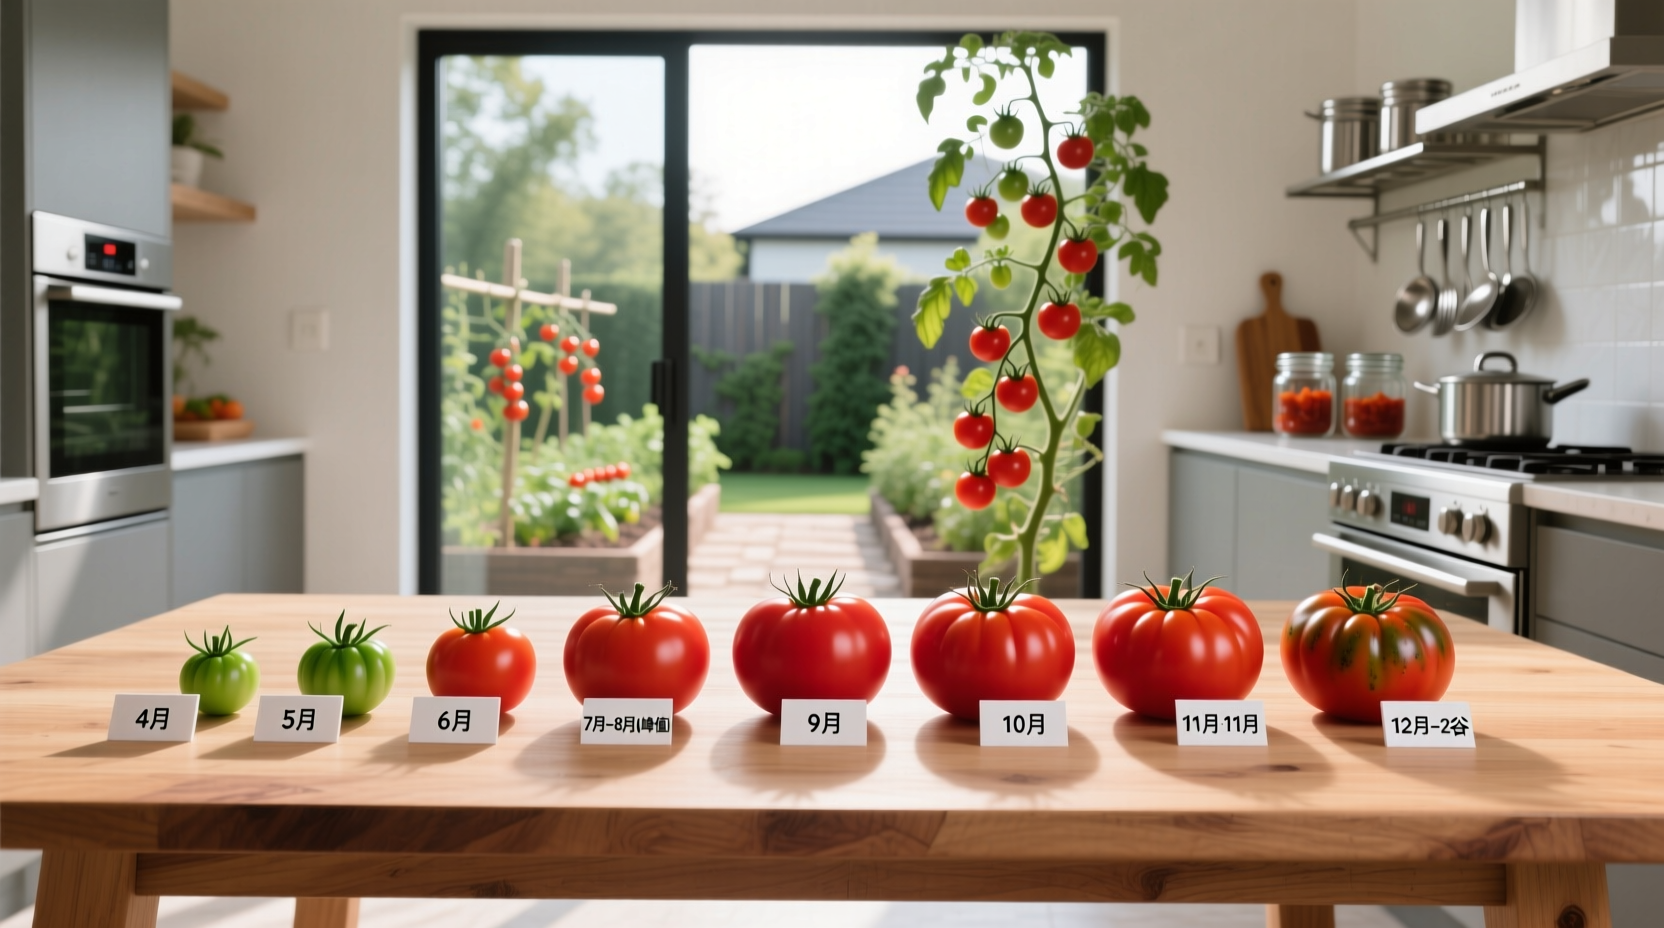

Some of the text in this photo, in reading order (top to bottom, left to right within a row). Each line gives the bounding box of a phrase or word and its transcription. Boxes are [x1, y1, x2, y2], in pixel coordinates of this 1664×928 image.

[135, 707, 170, 731] 4月
[281, 708, 316, 732] 5月
[437, 709, 471, 733] 6月
[807, 711, 840, 735] 9月
[1002, 713, 1045, 736] 10月
